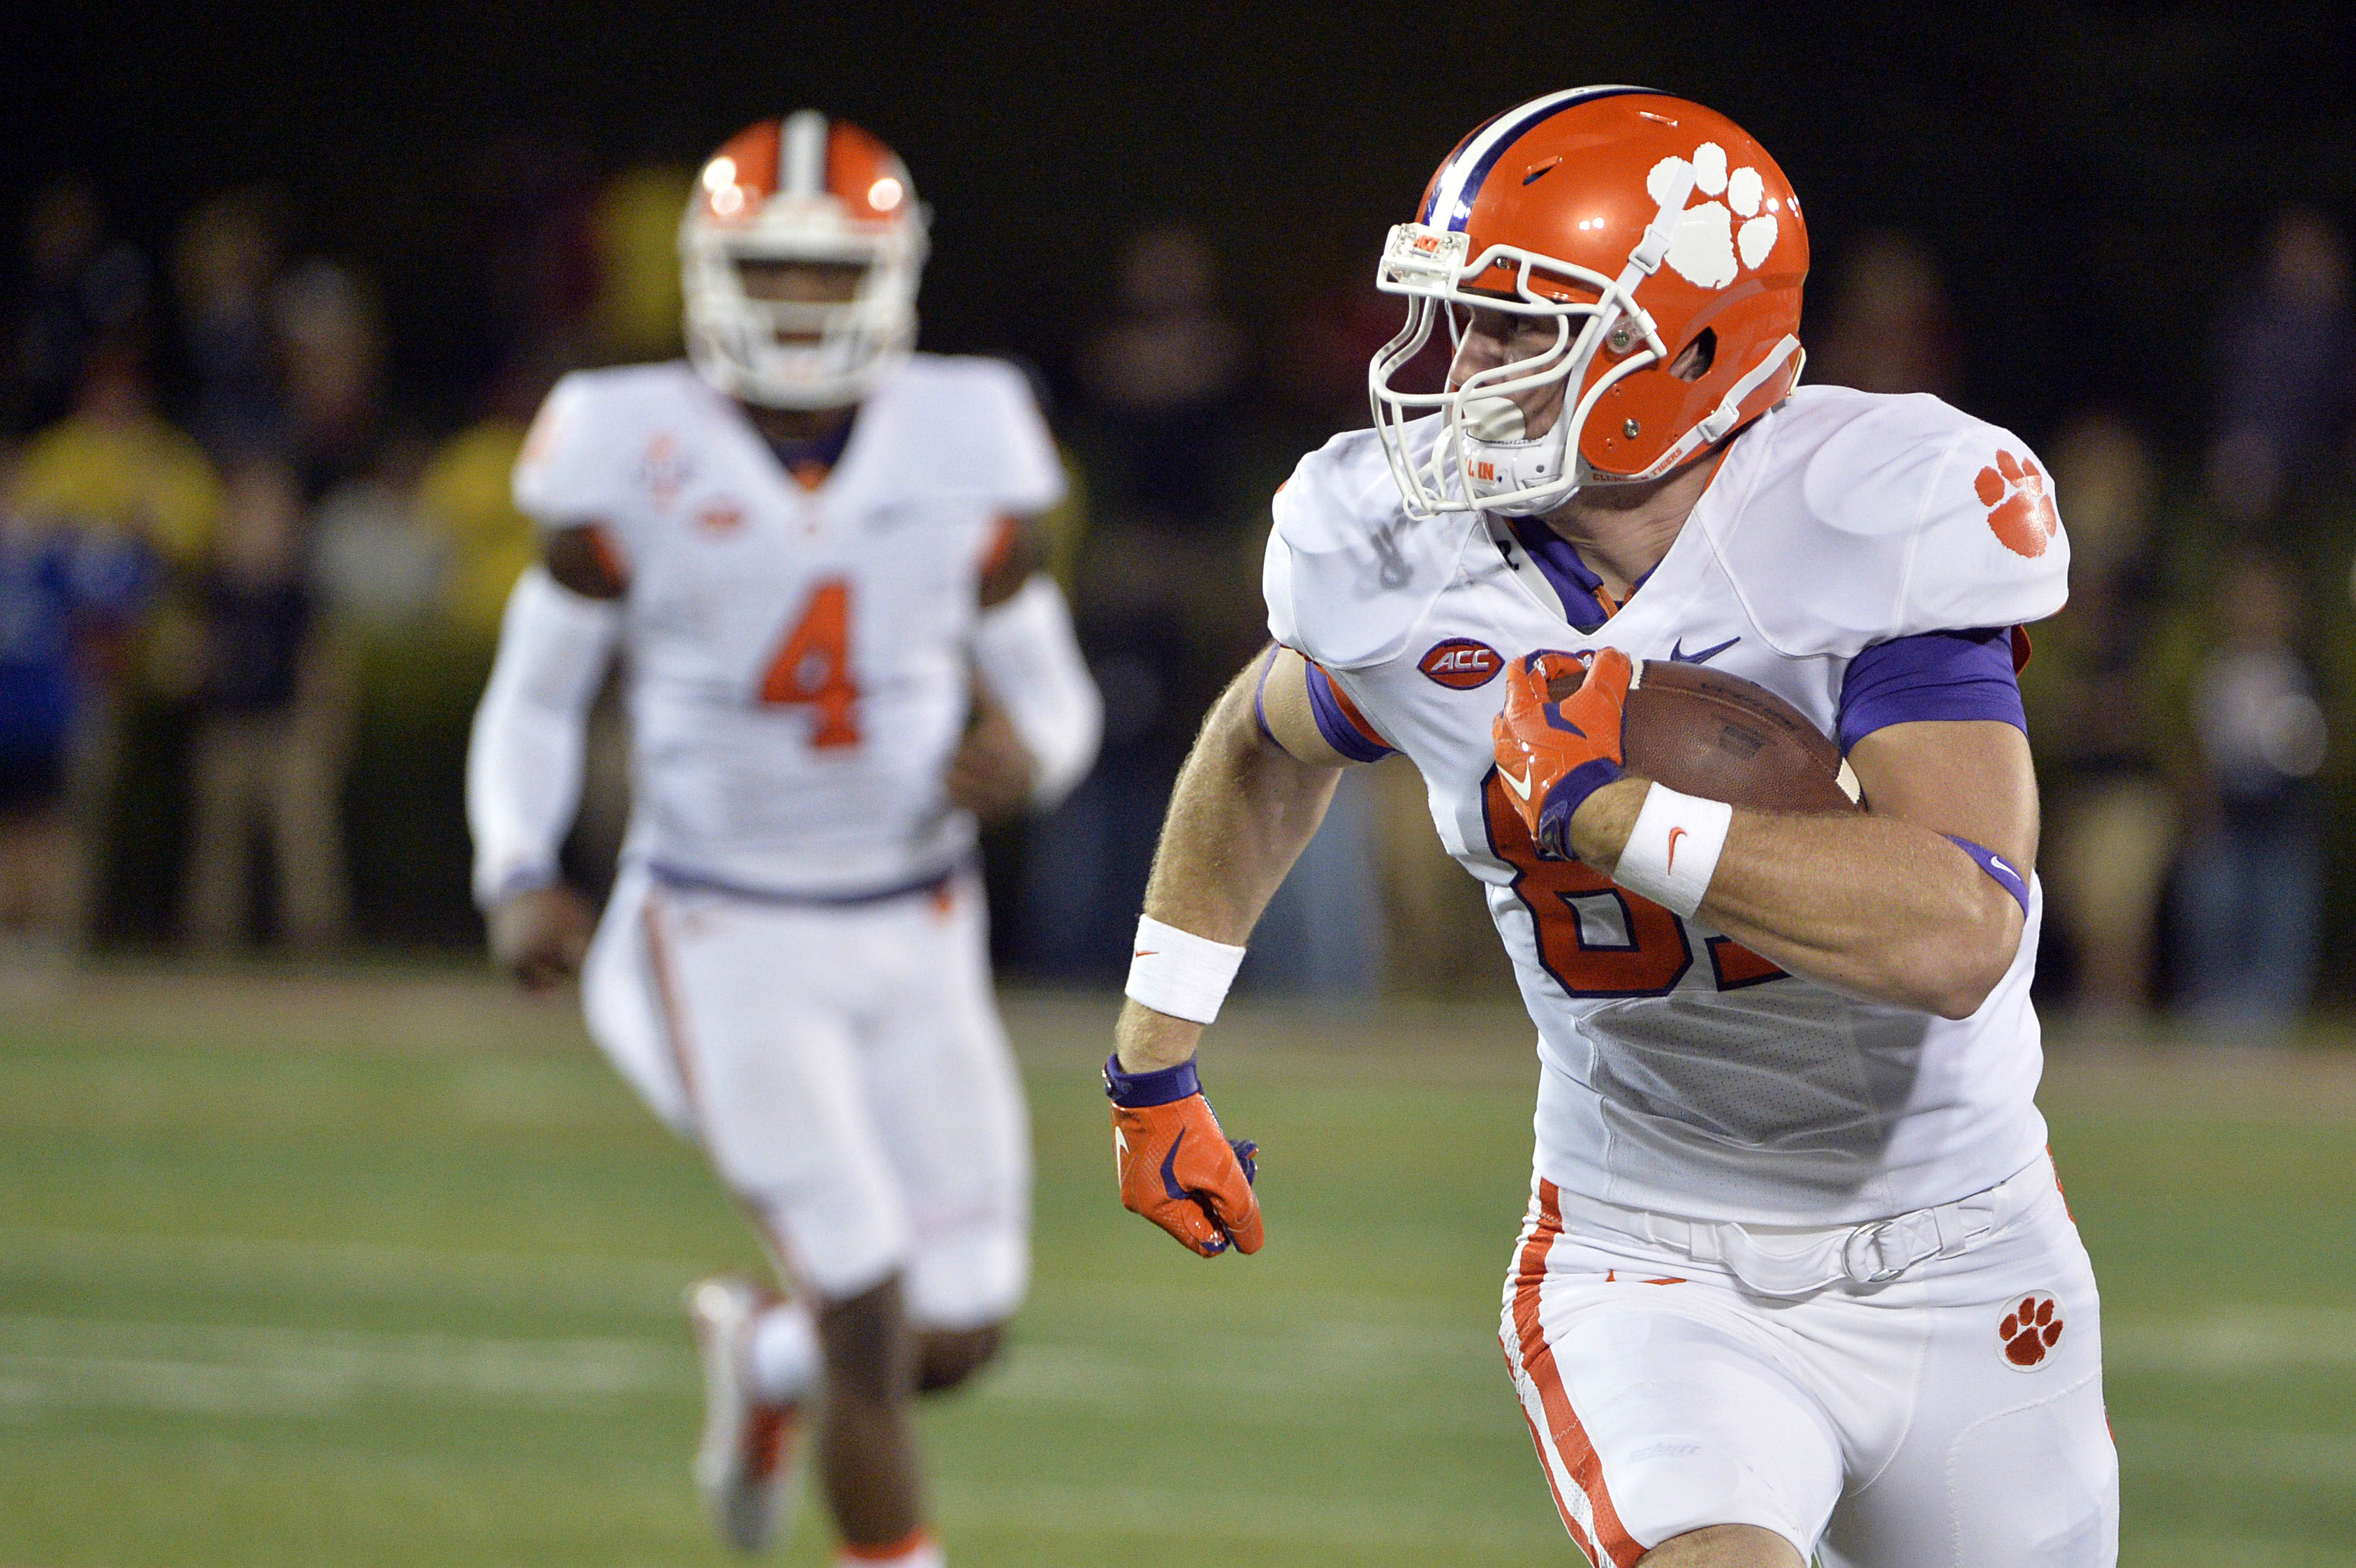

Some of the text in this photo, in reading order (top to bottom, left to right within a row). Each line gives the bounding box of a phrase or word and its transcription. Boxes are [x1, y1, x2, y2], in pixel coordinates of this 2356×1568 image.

[1478, 461, 1494, 480] IN
[1650, 448, 1683, 476] TIGERS
[757, 572, 864, 751] 4
[1430, 649, 1491, 671] ACC
[1480, 760, 1793, 998] 8
